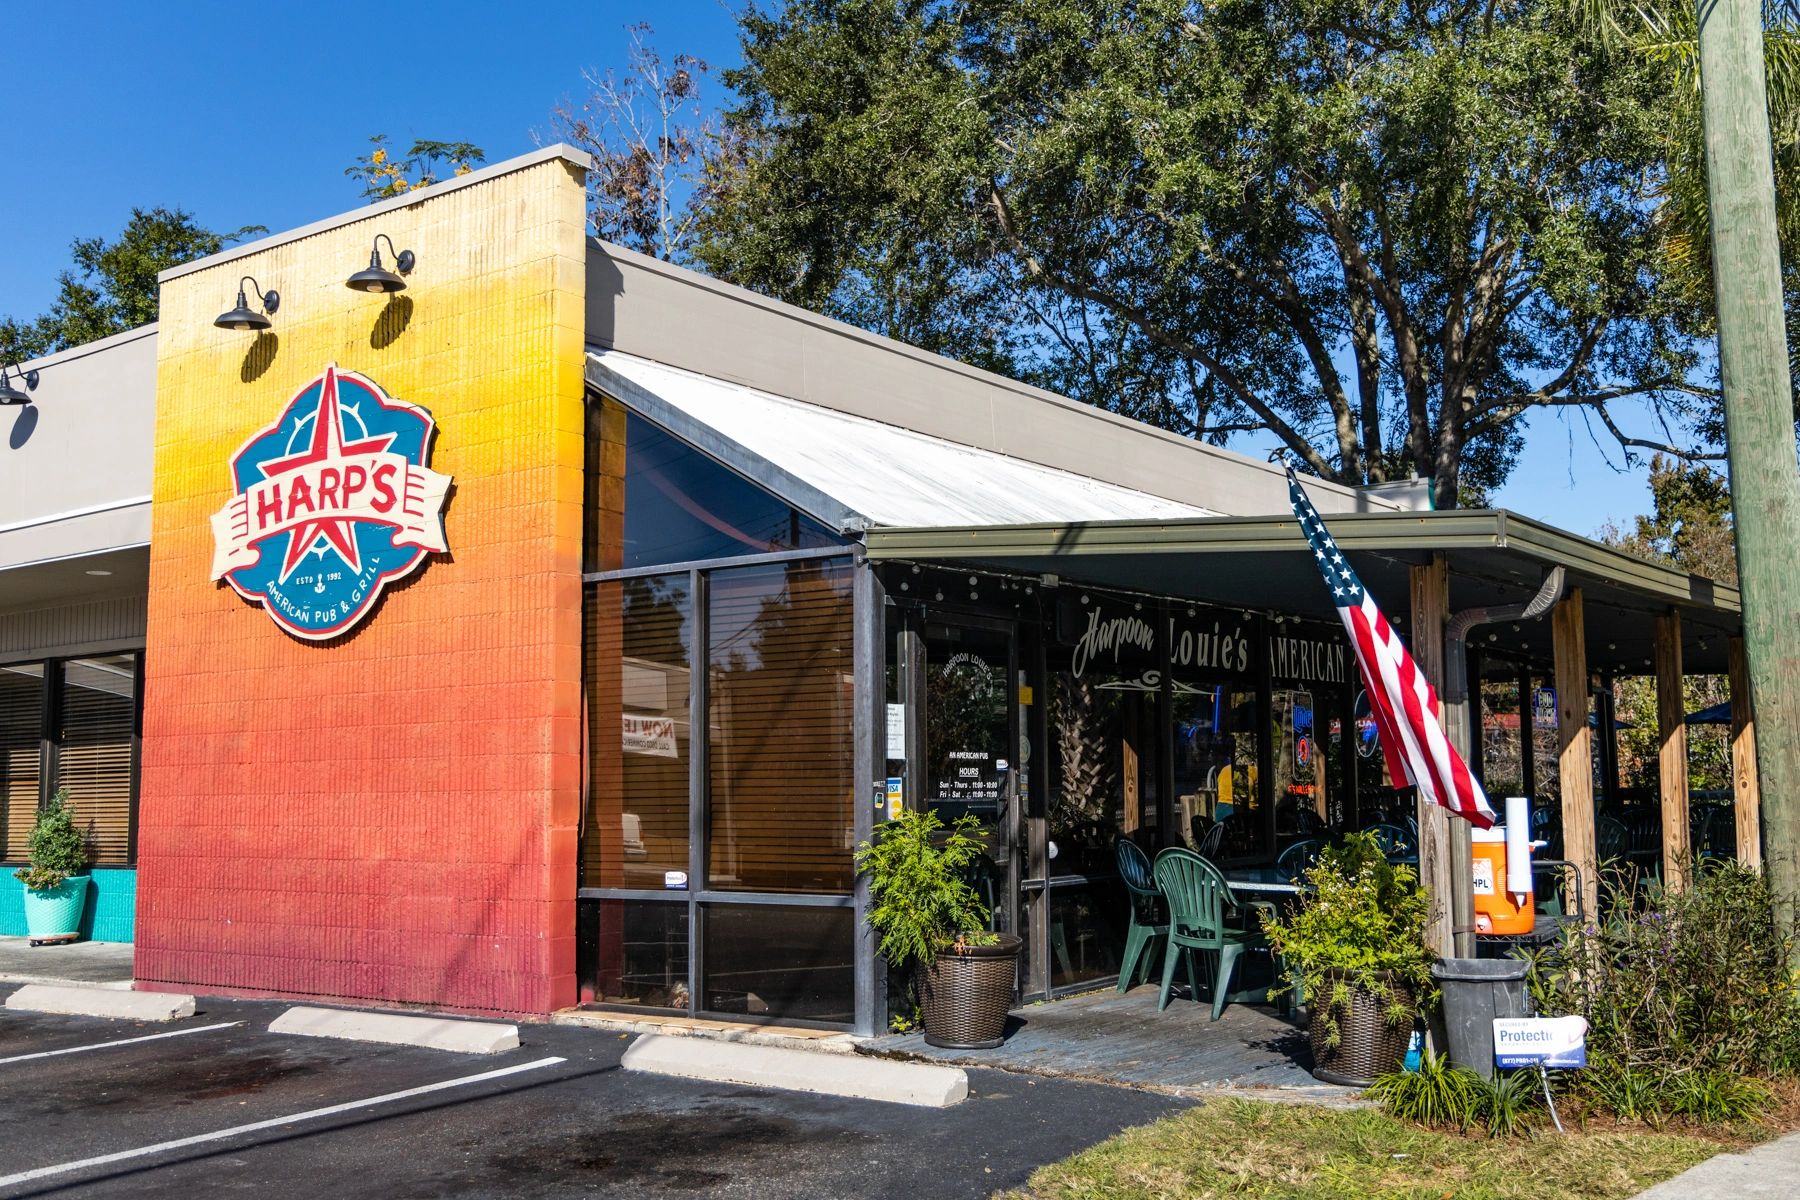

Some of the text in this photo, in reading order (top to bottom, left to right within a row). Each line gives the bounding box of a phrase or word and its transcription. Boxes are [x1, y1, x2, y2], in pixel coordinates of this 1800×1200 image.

[256, 460, 397, 530] HARP'S
[296, 571, 342, 585] ESTD 1992
[266, 557, 380, 623] AMERICAN PUB & GRILL
[1072, 606, 1155, 679] Harpoon
[1169, 617, 1248, 673] Louie's
[942, 652, 969, 678] HARPOON
[949, 751, 989, 760] AN AMERICAN PUB
[959, 767, 979, 776] HOURS
[886, 785, 899, 793] VISA
[940, 781, 949, 789] Sun
[954, 781, 968, 789] Thurs
[952, 790, 961, 798] Sat
